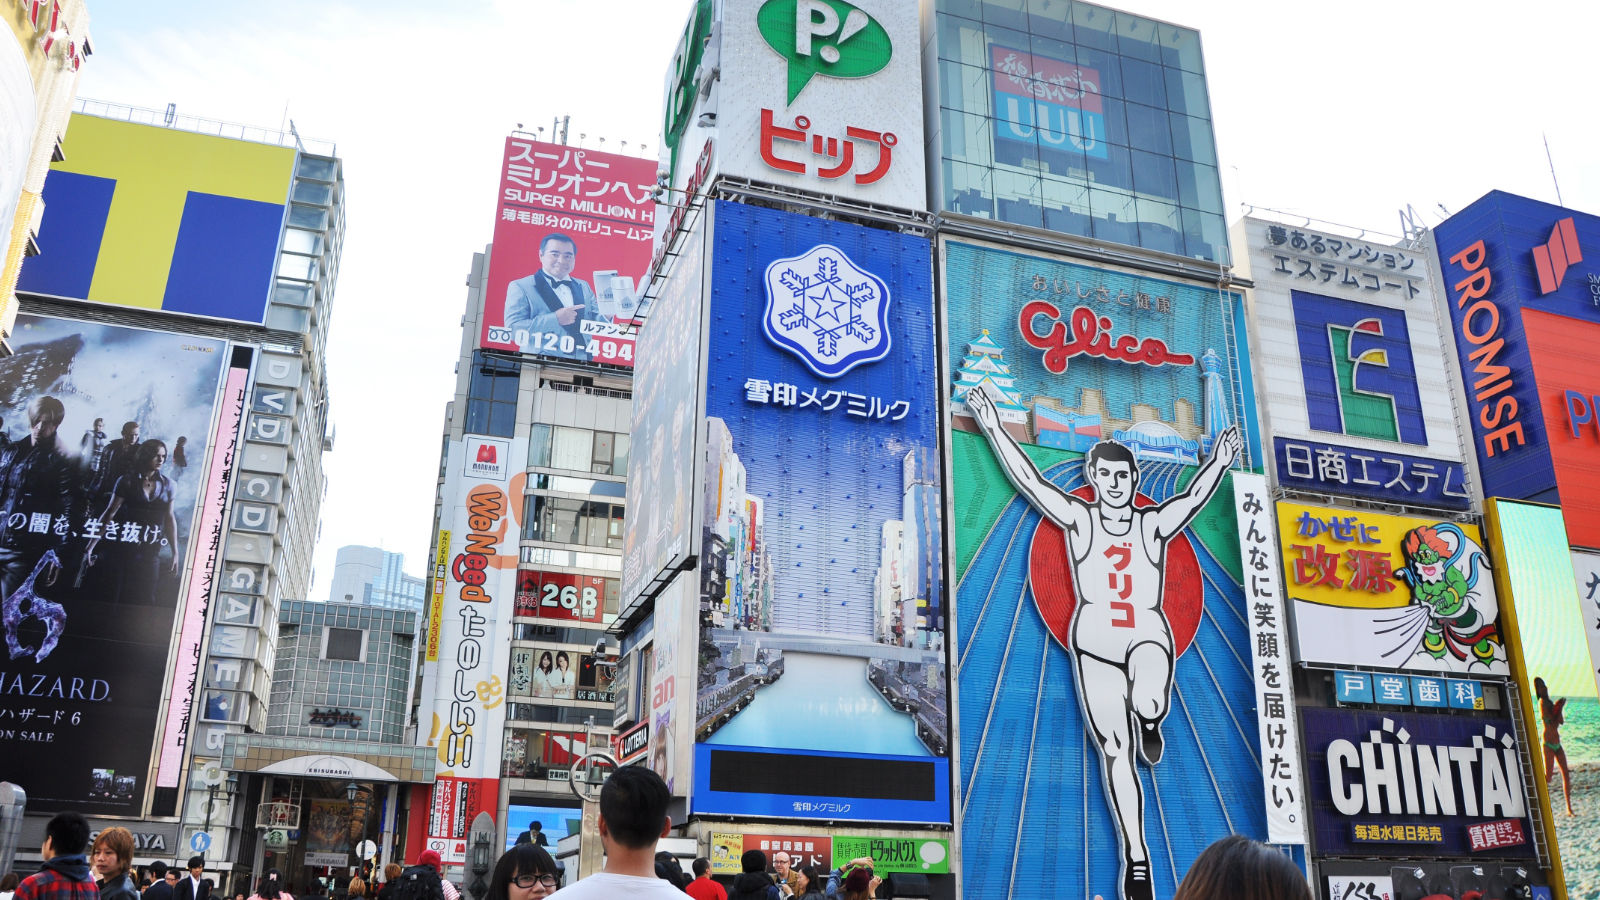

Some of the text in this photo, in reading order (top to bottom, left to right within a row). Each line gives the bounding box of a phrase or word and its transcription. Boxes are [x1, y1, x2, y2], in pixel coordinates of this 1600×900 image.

[509, 141, 610, 172] スーパー
[760, 108, 898, 185] ピップ
[506, 163, 656, 205] ミリオンヘア
[504, 188, 566, 209] SUPER
[570, 200, 636, 222] MILLION
[1268, 225, 1415, 271] 夢あるマンション
[1032, 273, 1172, 314] おいしさと健康
[1272, 254, 1421, 301] エステムコート
[1018, 299, 1196, 375] Glico
[1449, 239, 1527, 459] PROMISE
[743, 378, 911, 421] 雪印メグミルク
[1285, 443, 1470, 499] 日商エステム
[1296, 511, 1382, 544] かぜに
[1102, 541, 1136, 629] グリコ
[1289, 543, 1397, 594] 改源
[1242, 491, 1297, 824] みんなに笑顔を届けたい。
[652, 674, 675, 709] an
[1342, 675, 1476, 704] 戸堂歯科
[19, 731, 55, 743] SALE
[70, 710, 82, 726] 6
[308, 767, 351, 775] EBISUBASHI
[1326, 717, 1527, 818] CHINTAI
[792, 801, 851, 813] 雪印メグミルク
[869, 839, 918, 862] ピタットハウス
[1354, 824, 1443, 842] 毎週水曜日発売
[1468, 825, 1499, 849] 賃貸
[1499, 831, 1524, 845] ニュース
